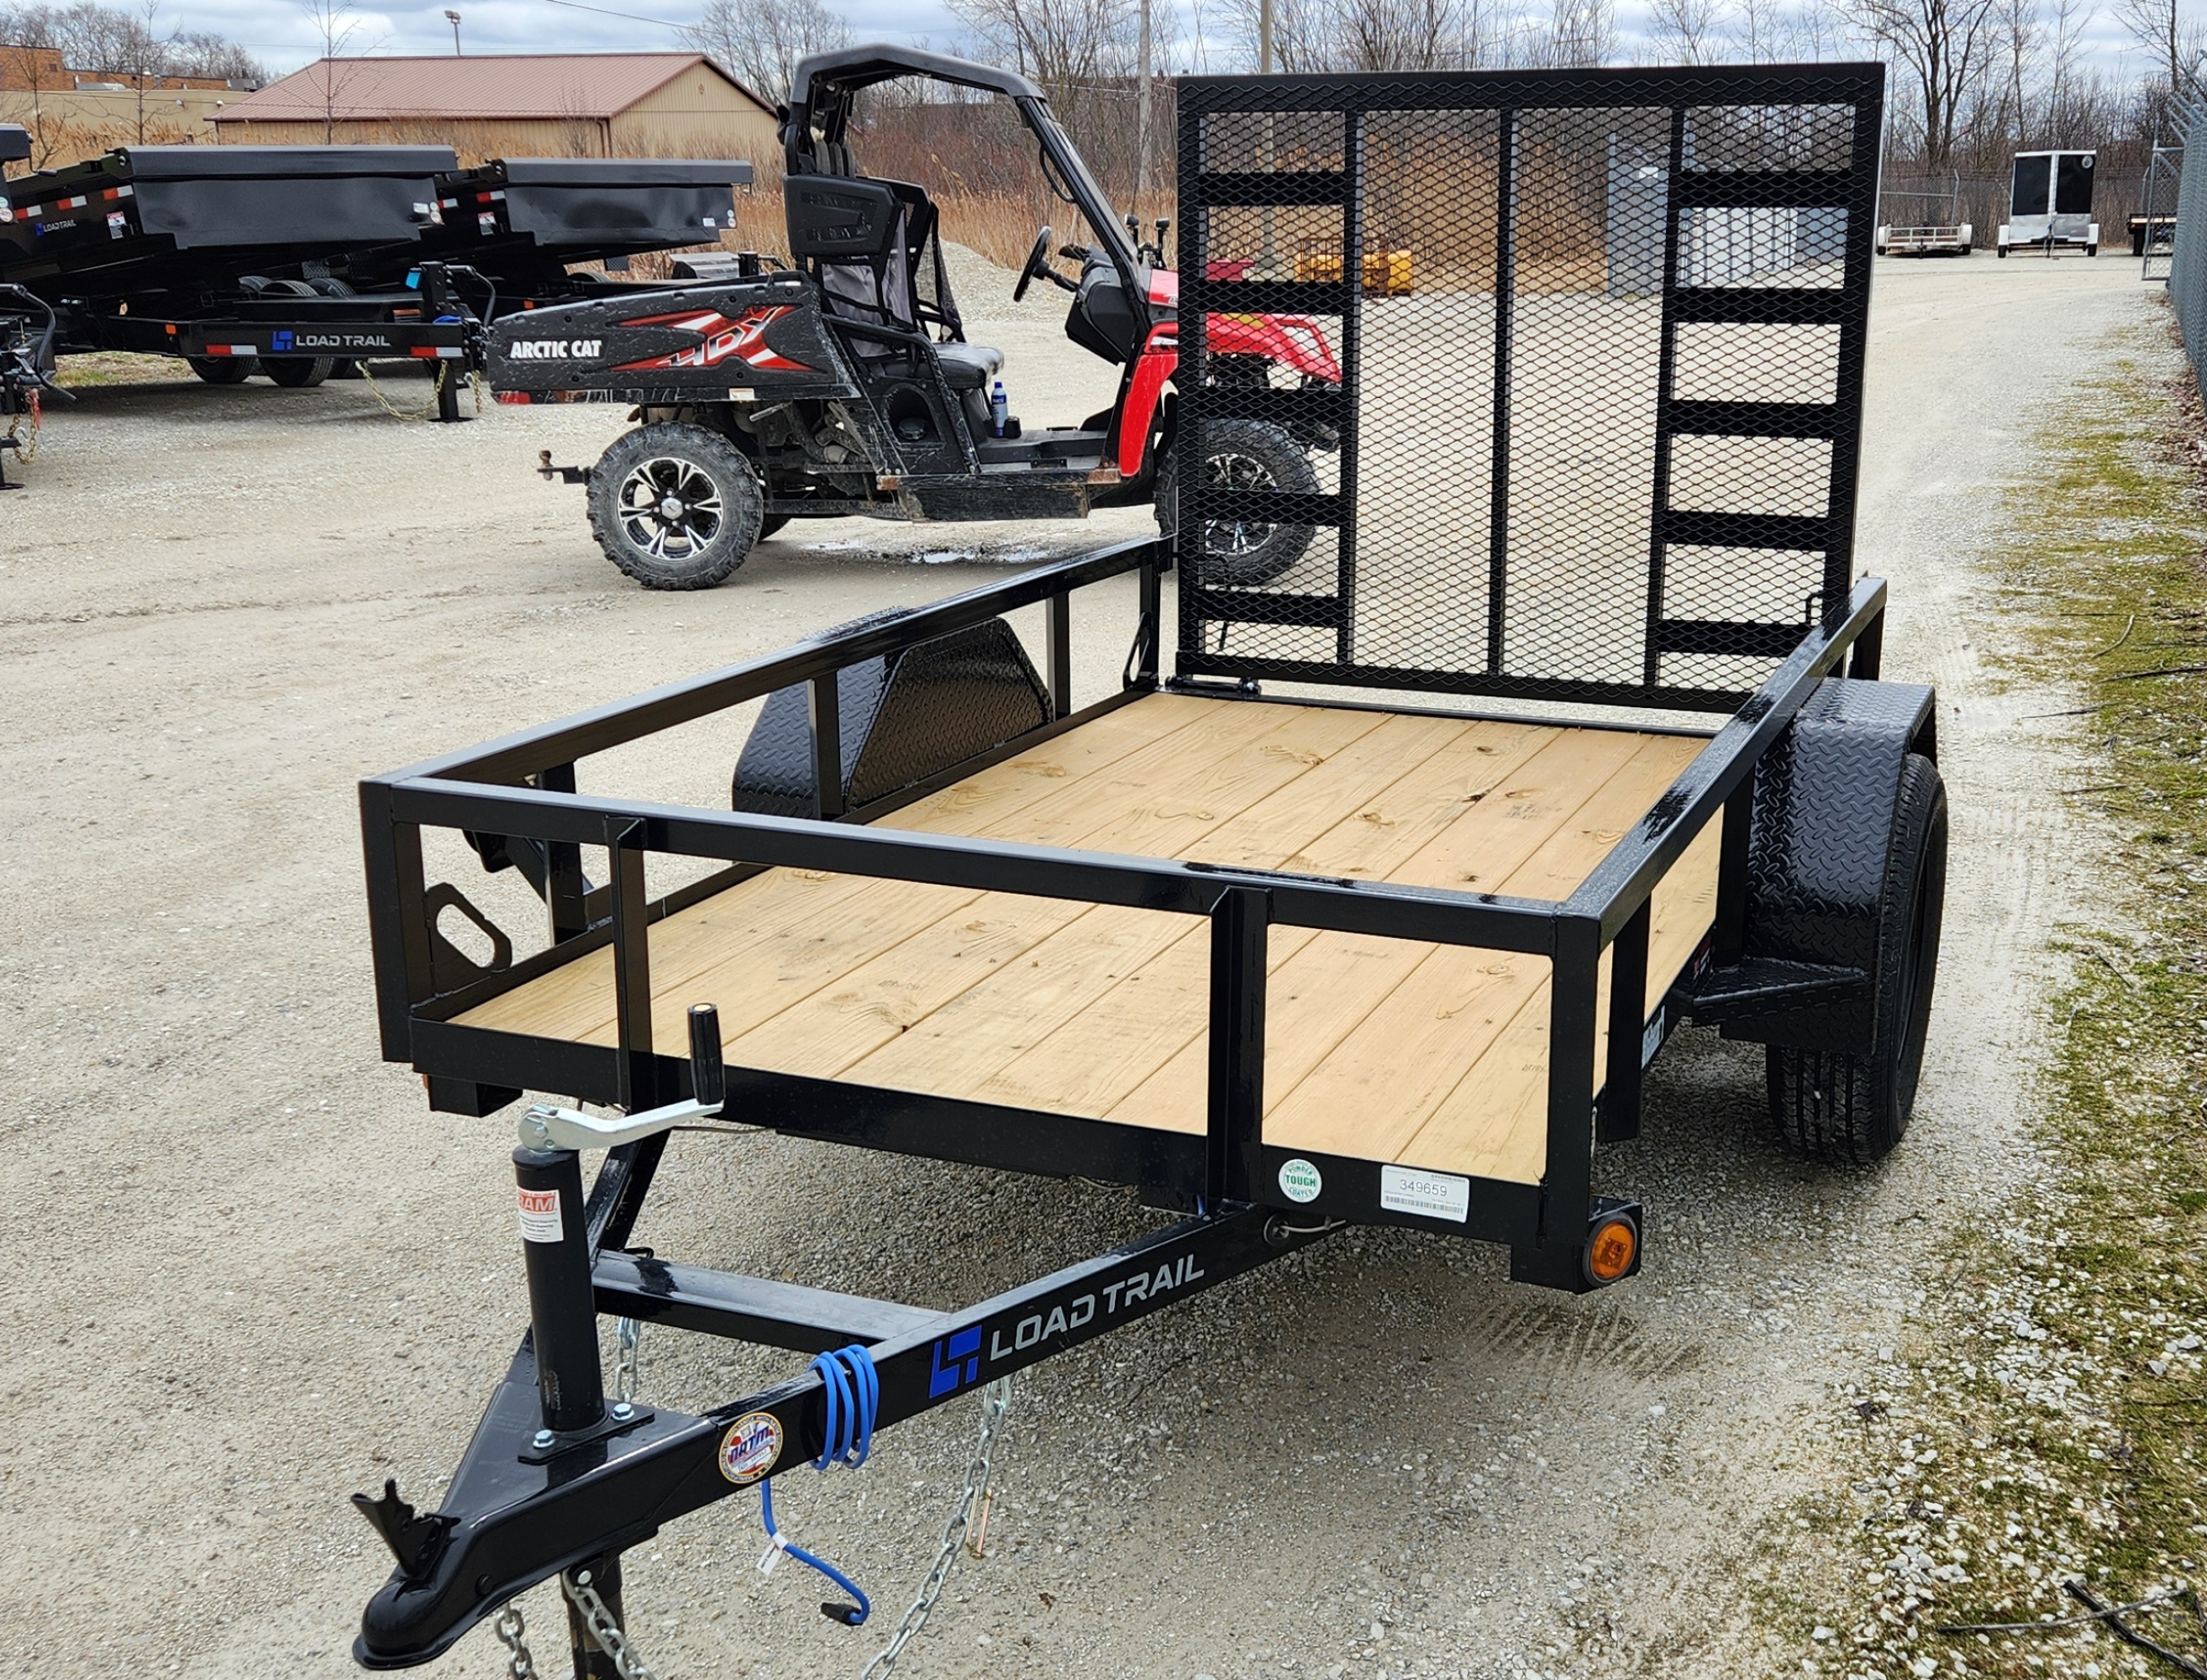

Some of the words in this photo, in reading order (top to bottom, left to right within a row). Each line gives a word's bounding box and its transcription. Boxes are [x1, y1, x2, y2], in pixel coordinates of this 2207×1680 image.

[44, 223, 59, 232] LOAD
[59, 219, 77, 229] TRAIL
[296, 335, 340, 346] LOAD
[342, 335, 391, 347] TRAIL
[655, 306, 784, 367] HDX
[510, 340, 568, 359] ARCTIC
[571, 339, 602, 358] CAT
[1285, 1174, 1316, 1187] TOUGH
[1400, 1179, 1448, 1197] 349659
[990, 1294, 1096, 1362] LOAD
[1102, 1253, 1206, 1314] TRAIL
